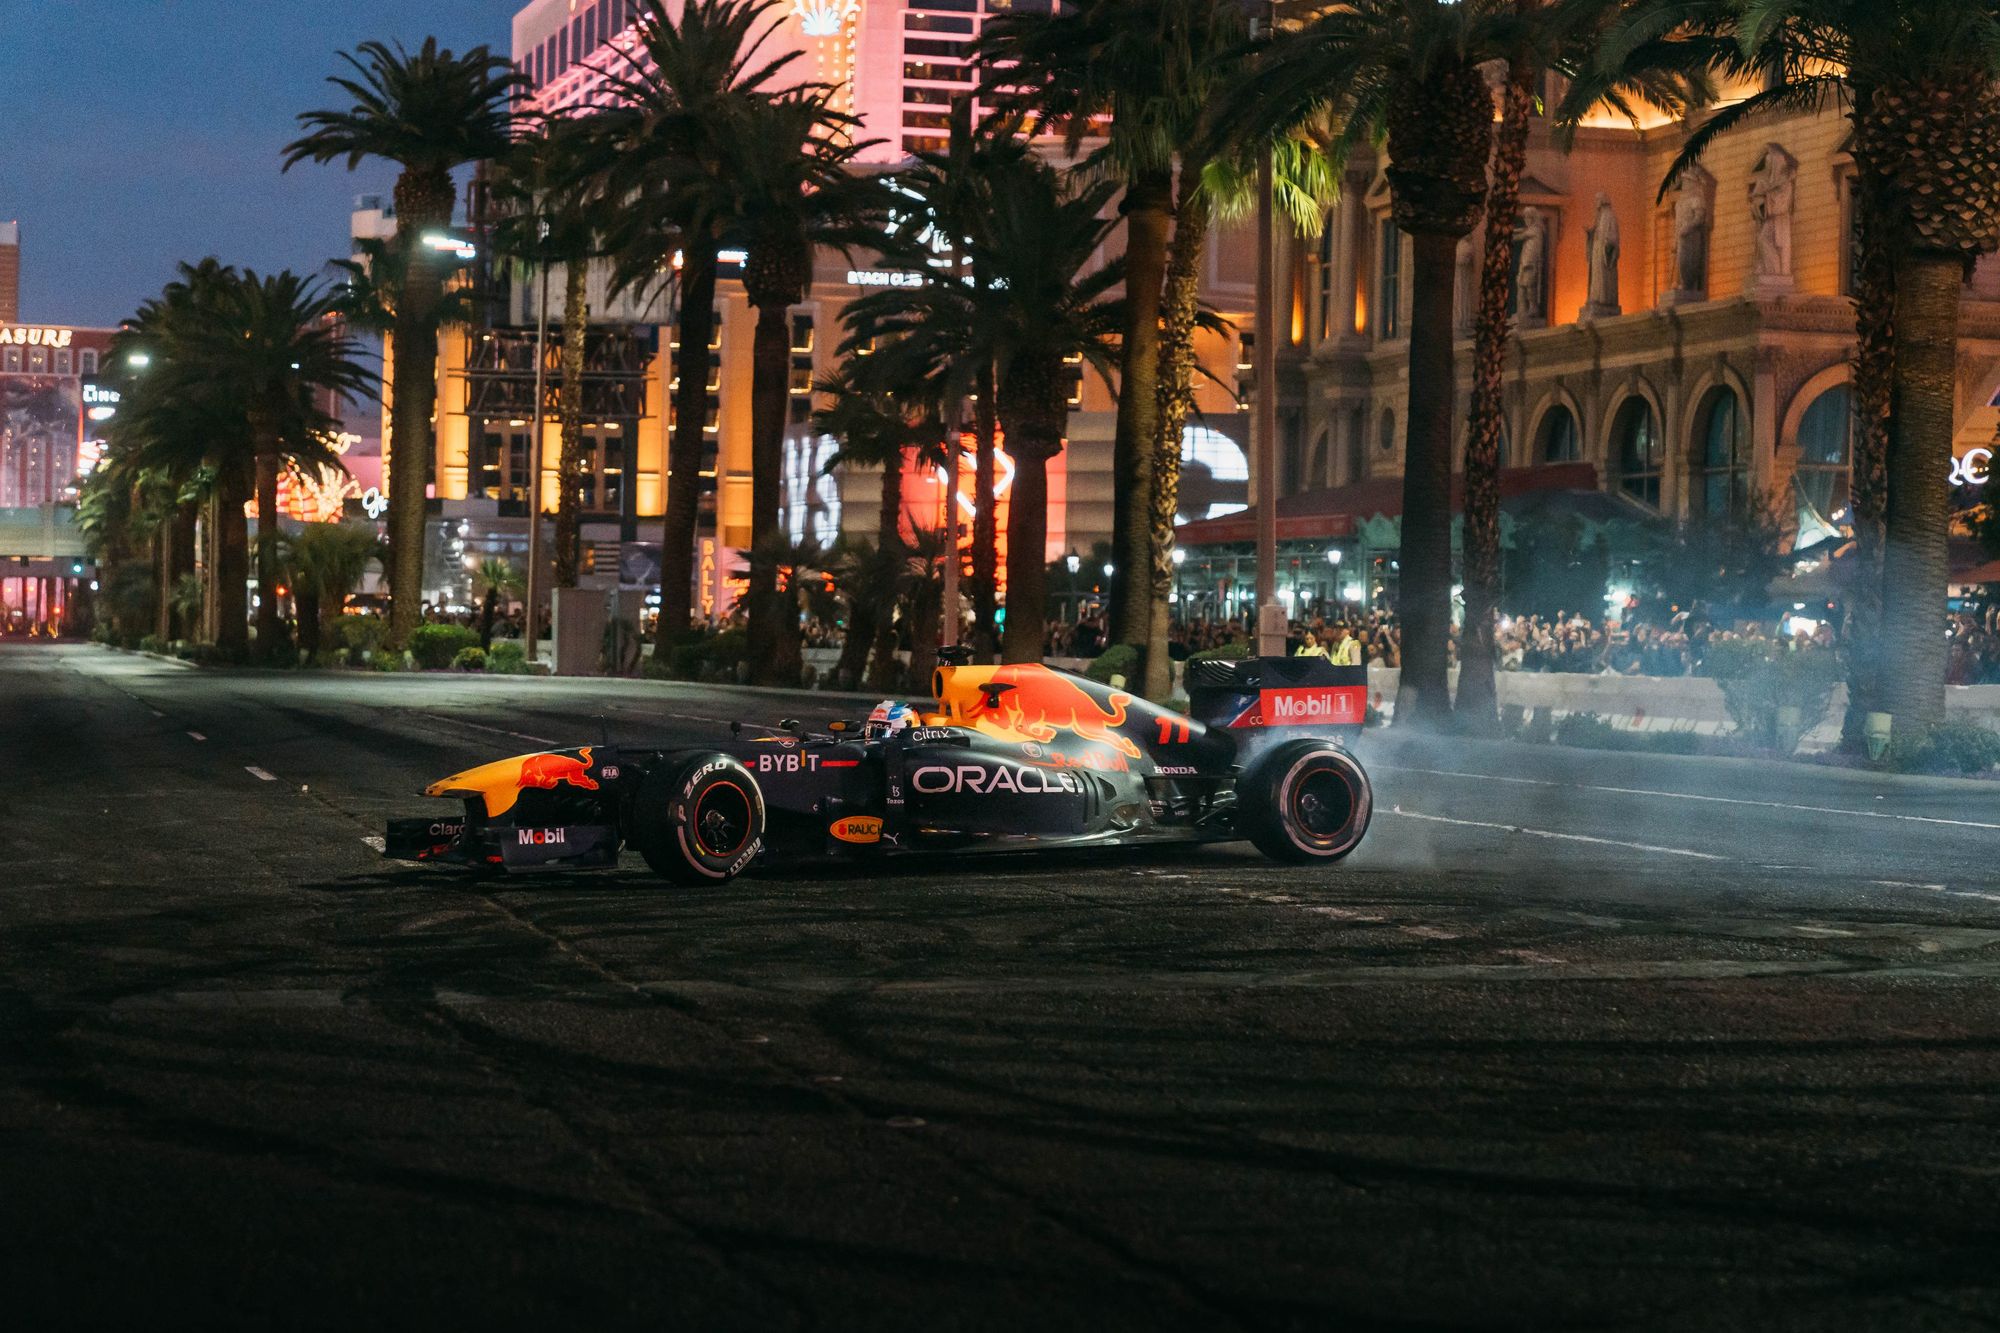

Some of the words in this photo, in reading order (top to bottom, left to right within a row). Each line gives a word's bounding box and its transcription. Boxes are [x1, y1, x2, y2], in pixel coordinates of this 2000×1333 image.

[847, 271, 889, 286] BEACH
[1274, 694, 1331, 717] Mobil
[912, 727, 949, 742] citrix
[1155, 716, 1191, 745] 11
[759, 750, 819, 772] BYBIT
[1154, 766, 1198, 775] HONDA
[602, 767, 618, 778] FIA
[683, 761, 727, 799] ZERO
[912, 765, 1084, 795] ORACLE
[518, 828, 566, 846] Mobil
